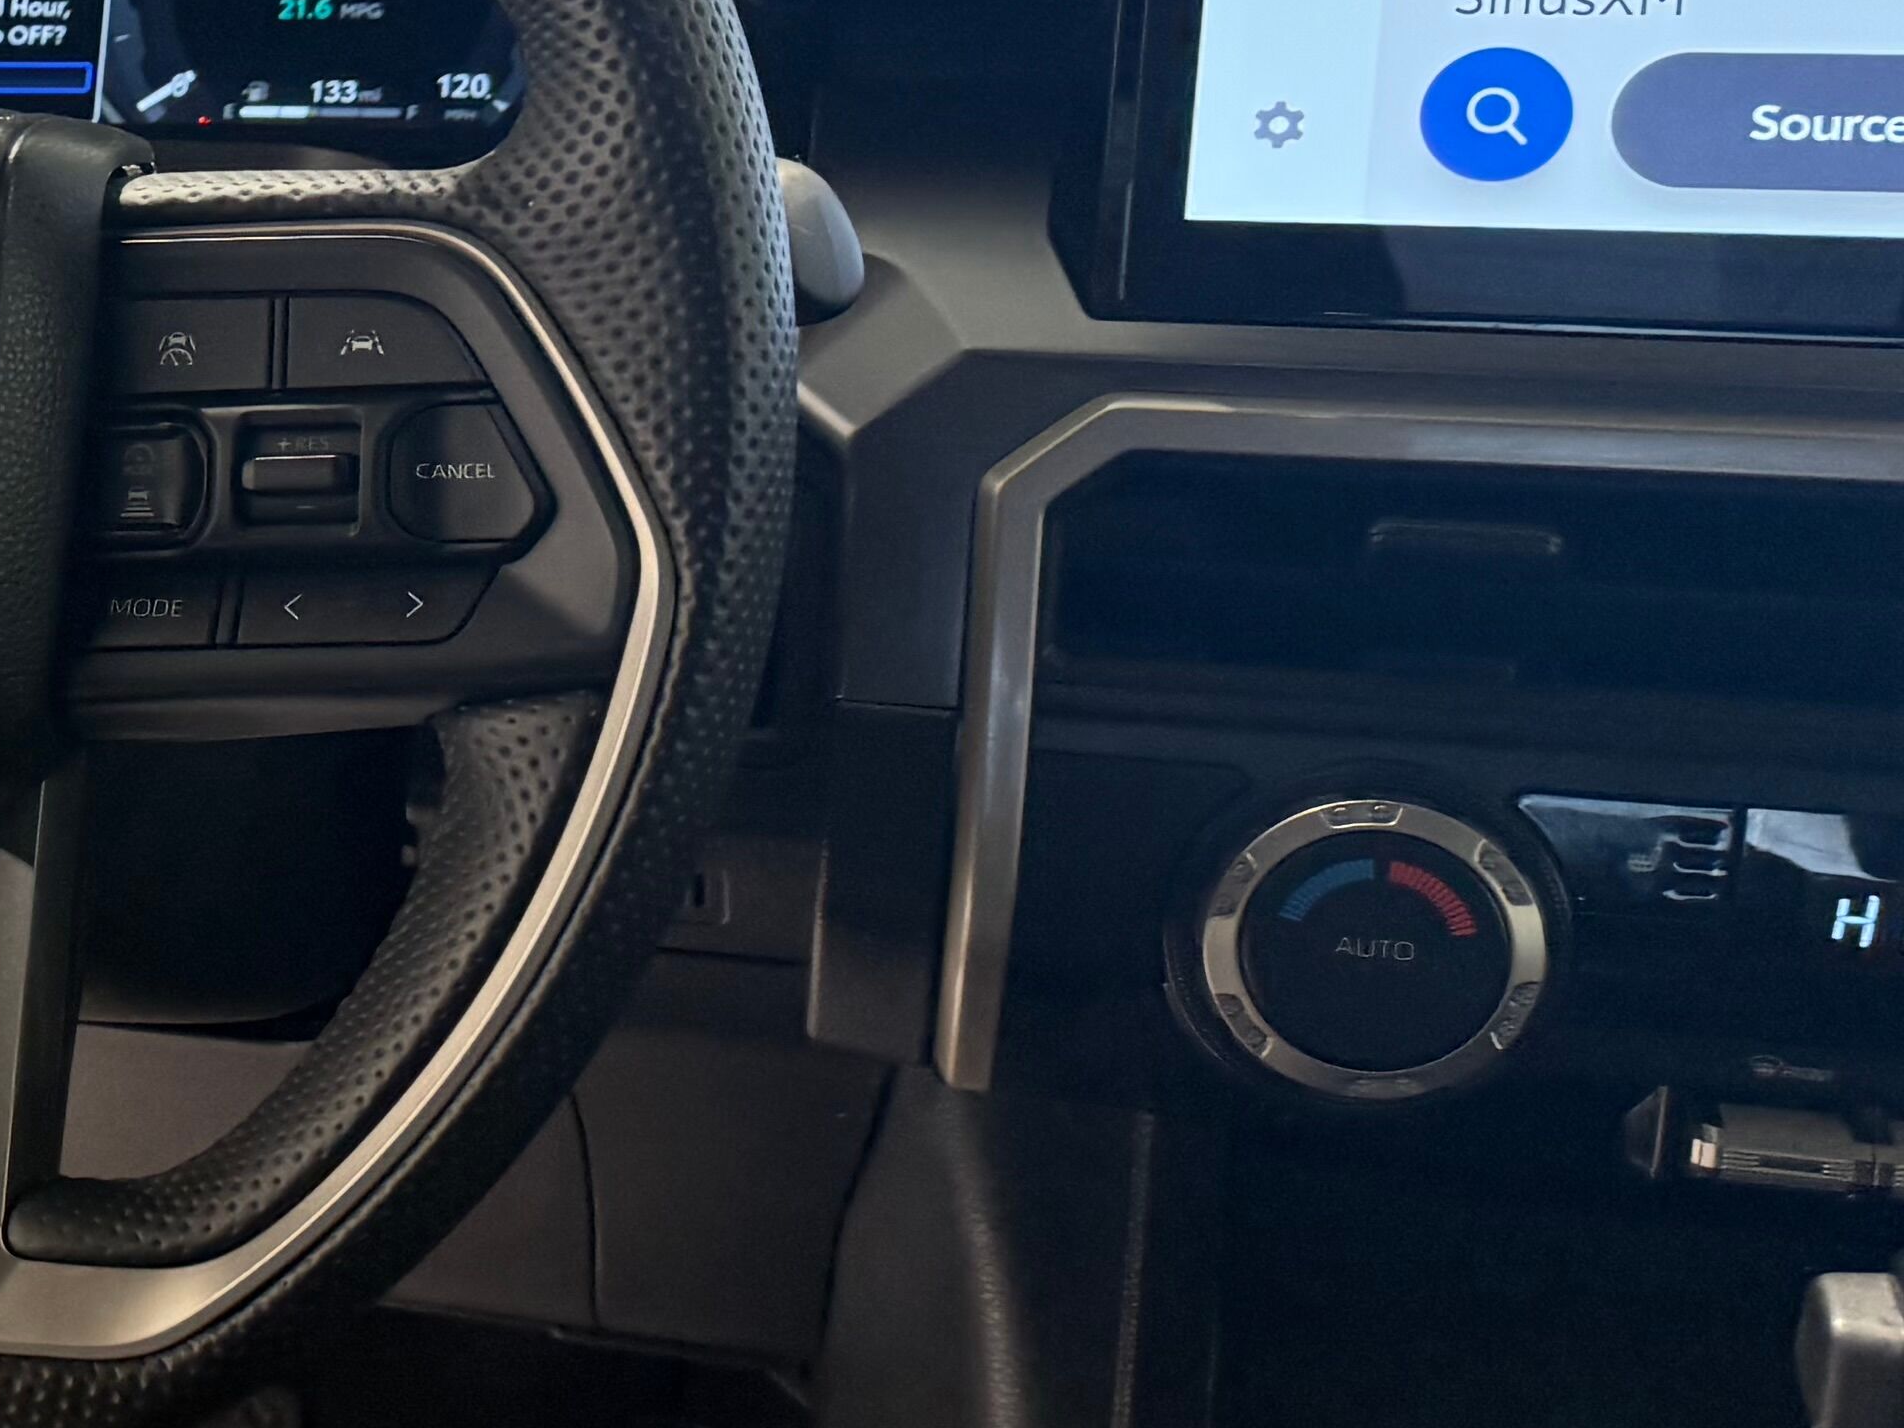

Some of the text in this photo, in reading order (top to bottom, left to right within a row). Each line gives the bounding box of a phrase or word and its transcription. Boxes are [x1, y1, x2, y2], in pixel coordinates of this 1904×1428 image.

[340, 2, 384, 19] MPG
[7, 24, 68, 46] OFF?
[310, 79, 358, 103] 133
[437, 73, 491, 99] 120
[416, 462, 495, 481] CANCEL
[110, 598, 184, 618] MODE
[1335, 937, 1416, 961] AUTO
